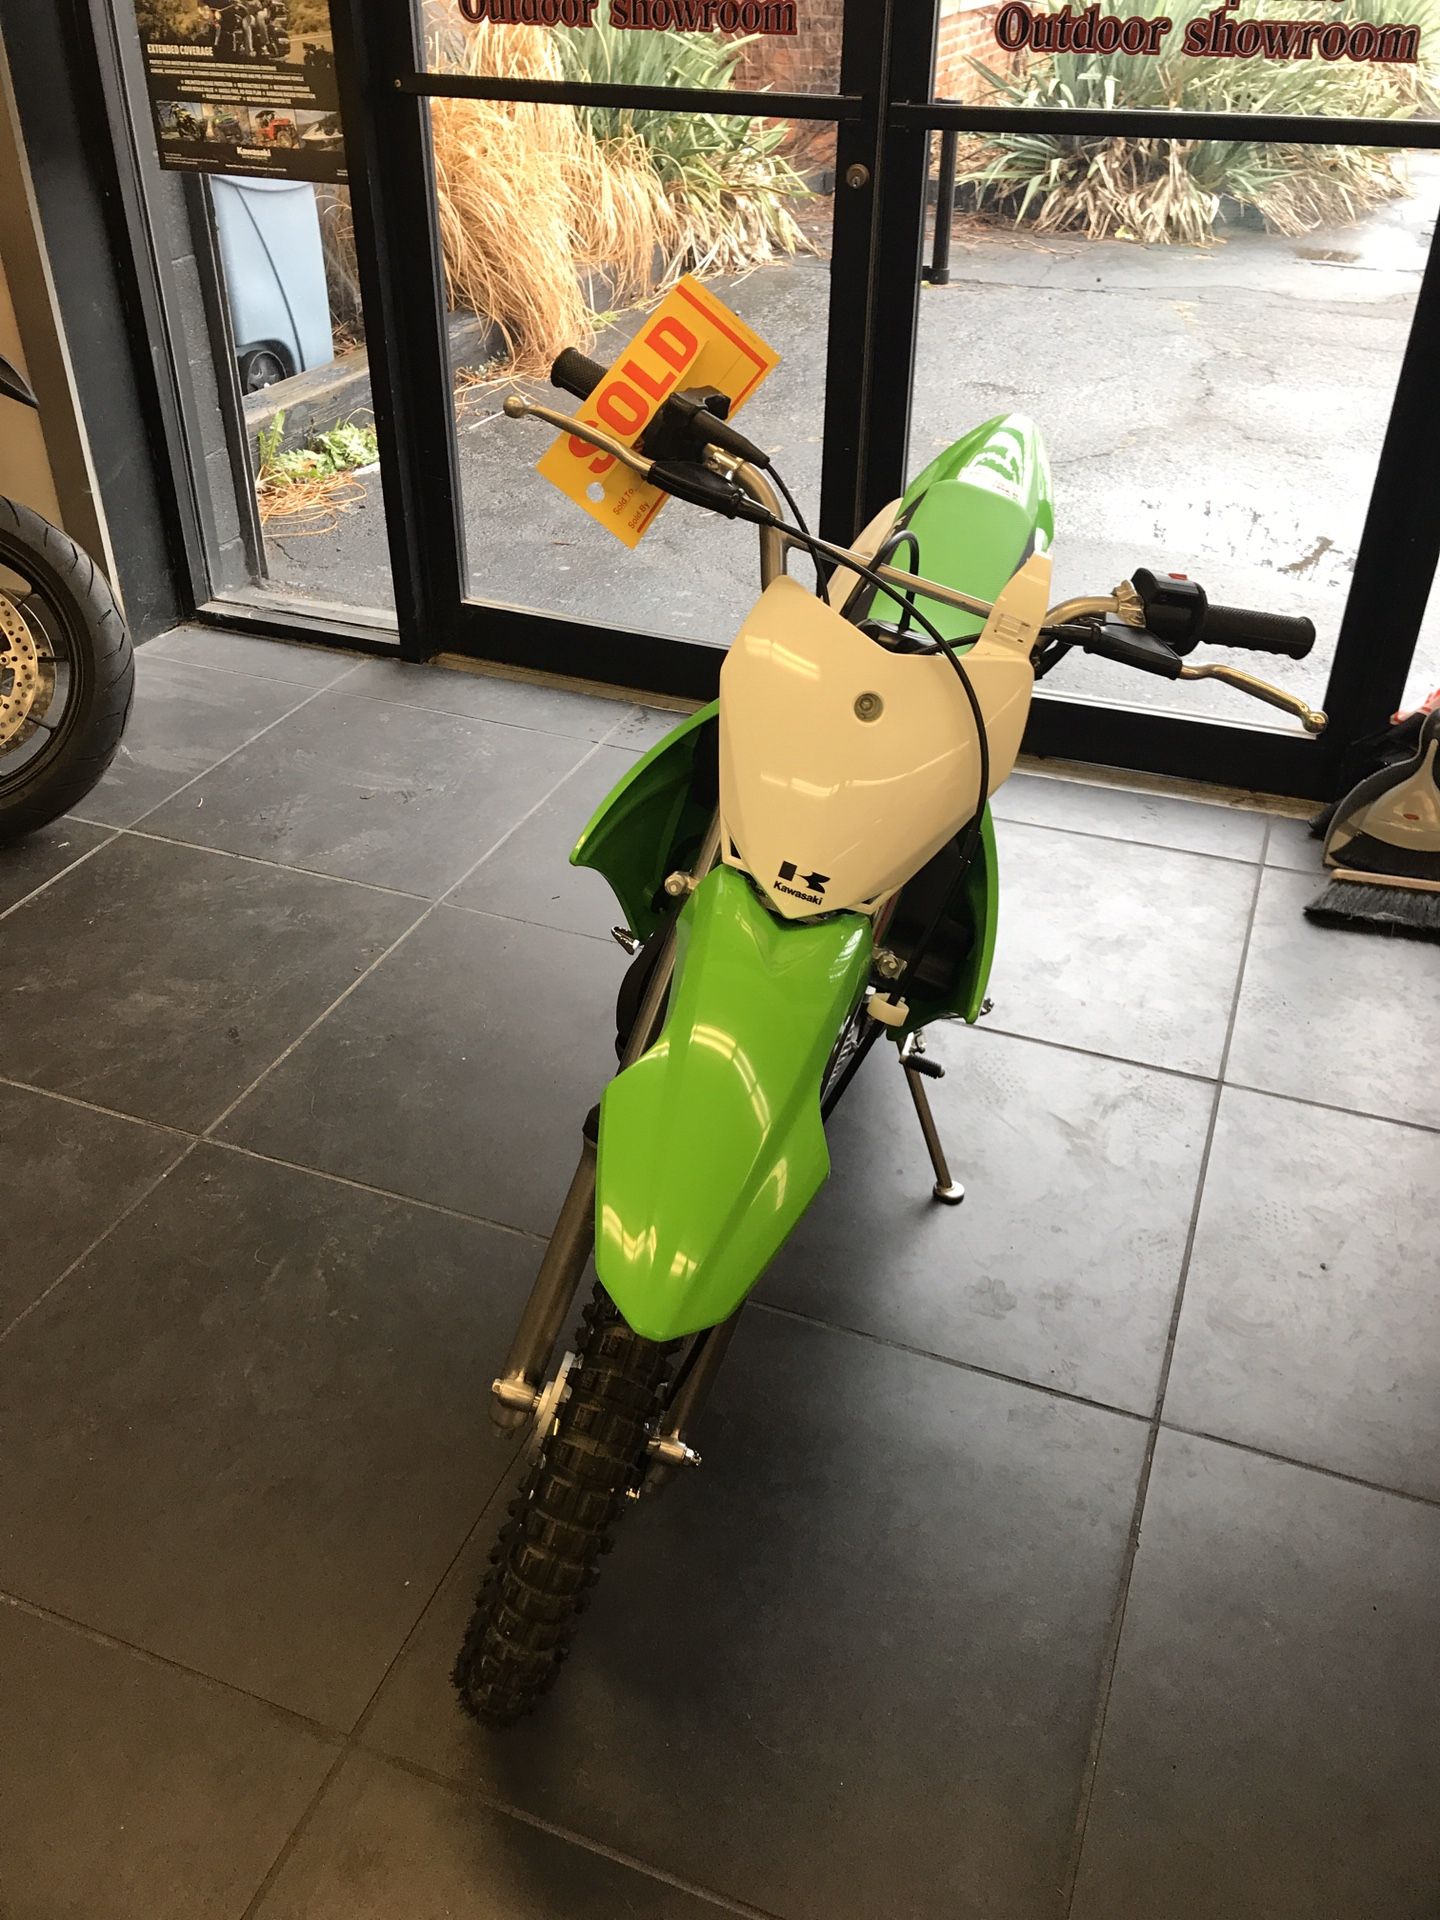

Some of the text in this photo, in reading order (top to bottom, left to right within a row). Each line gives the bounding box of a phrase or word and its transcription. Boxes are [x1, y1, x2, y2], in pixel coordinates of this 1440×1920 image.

[459, 0, 797, 35] Outdoor showroom
[995, 1, 1421, 63] Outdoor showroom
[147, 43, 214, 57] EXTENDED COVERAGE
[568, 315, 698, 474] SOLD
[613, 497, 627, 515] Sold
[628, 511, 642, 529] Sold
[773, 880, 824, 906] Kawasaki
